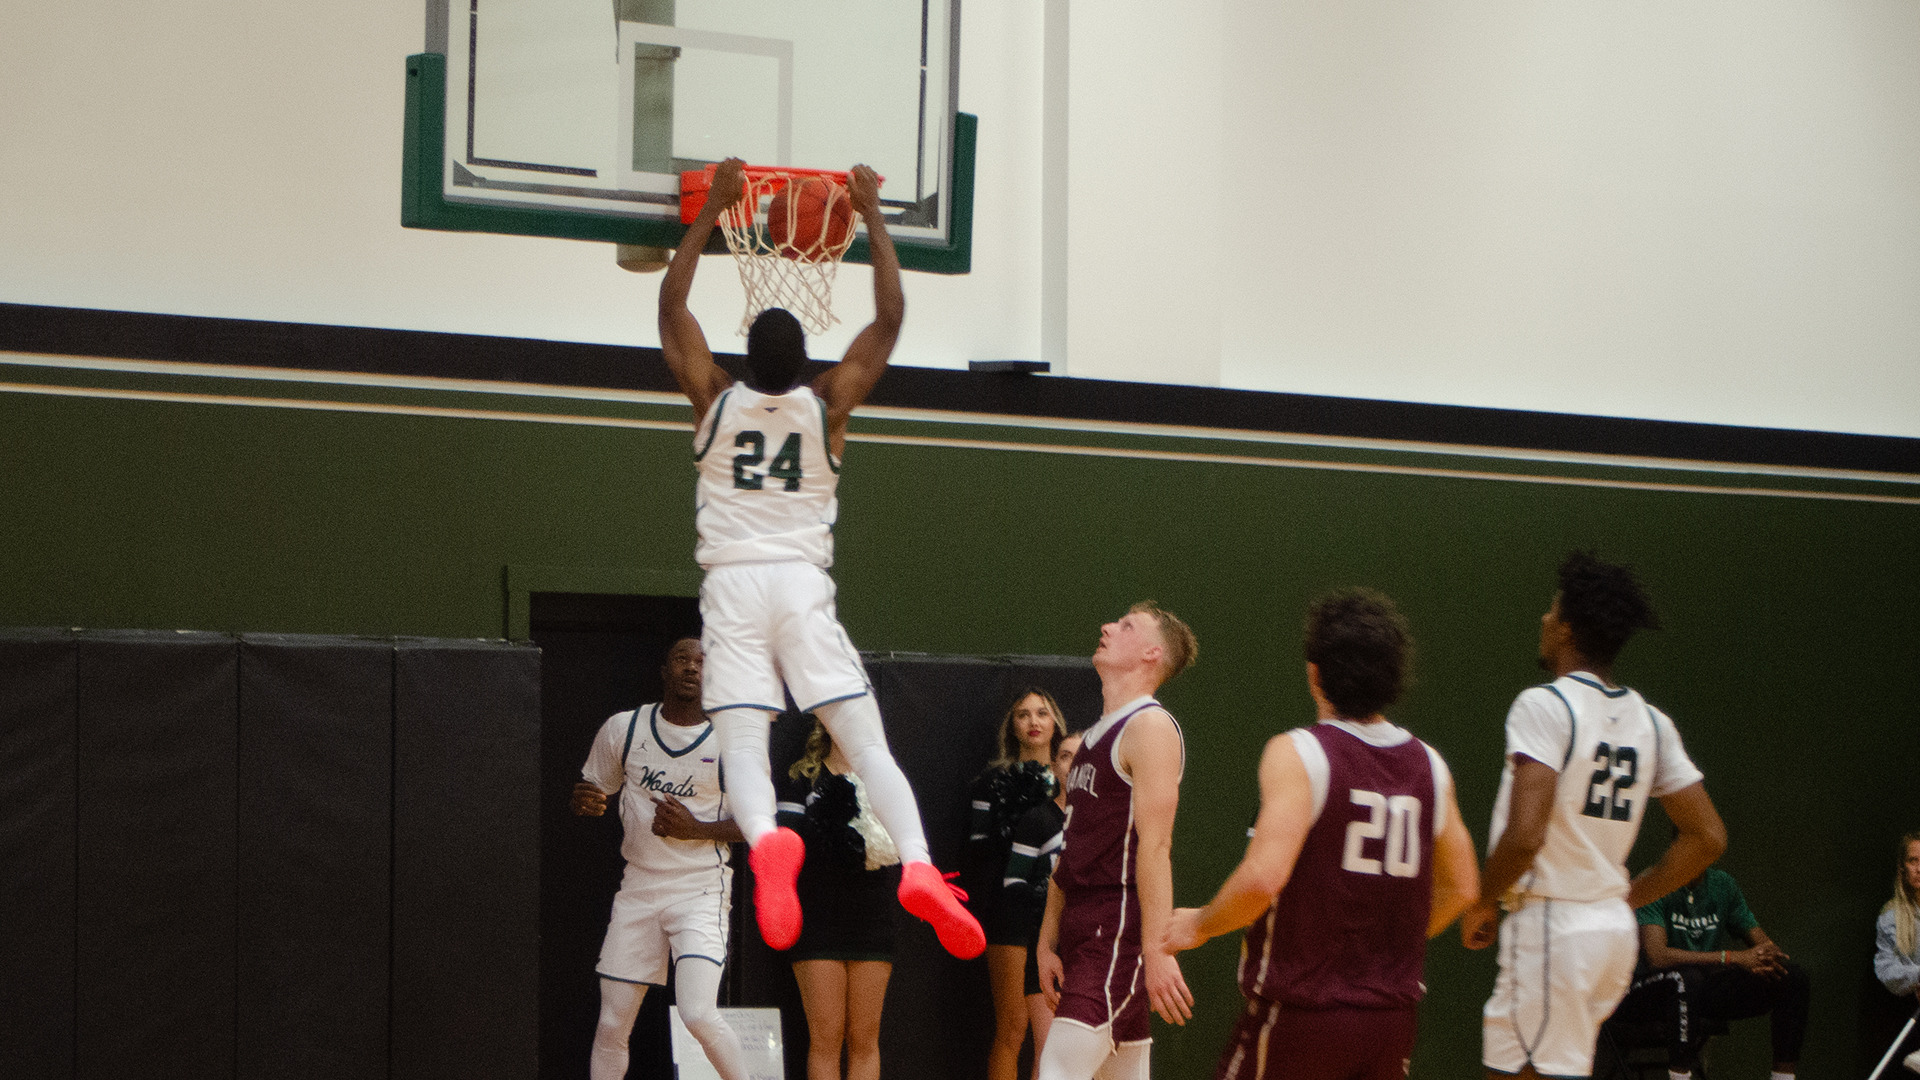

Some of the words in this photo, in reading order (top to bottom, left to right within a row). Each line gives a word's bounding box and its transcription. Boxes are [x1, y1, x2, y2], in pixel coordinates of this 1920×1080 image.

[733, 430, 803, 492] 24
[640, 765, 698, 797] Woods
[1581, 741, 1638, 822] 22
[1342, 788, 1422, 878] 20
